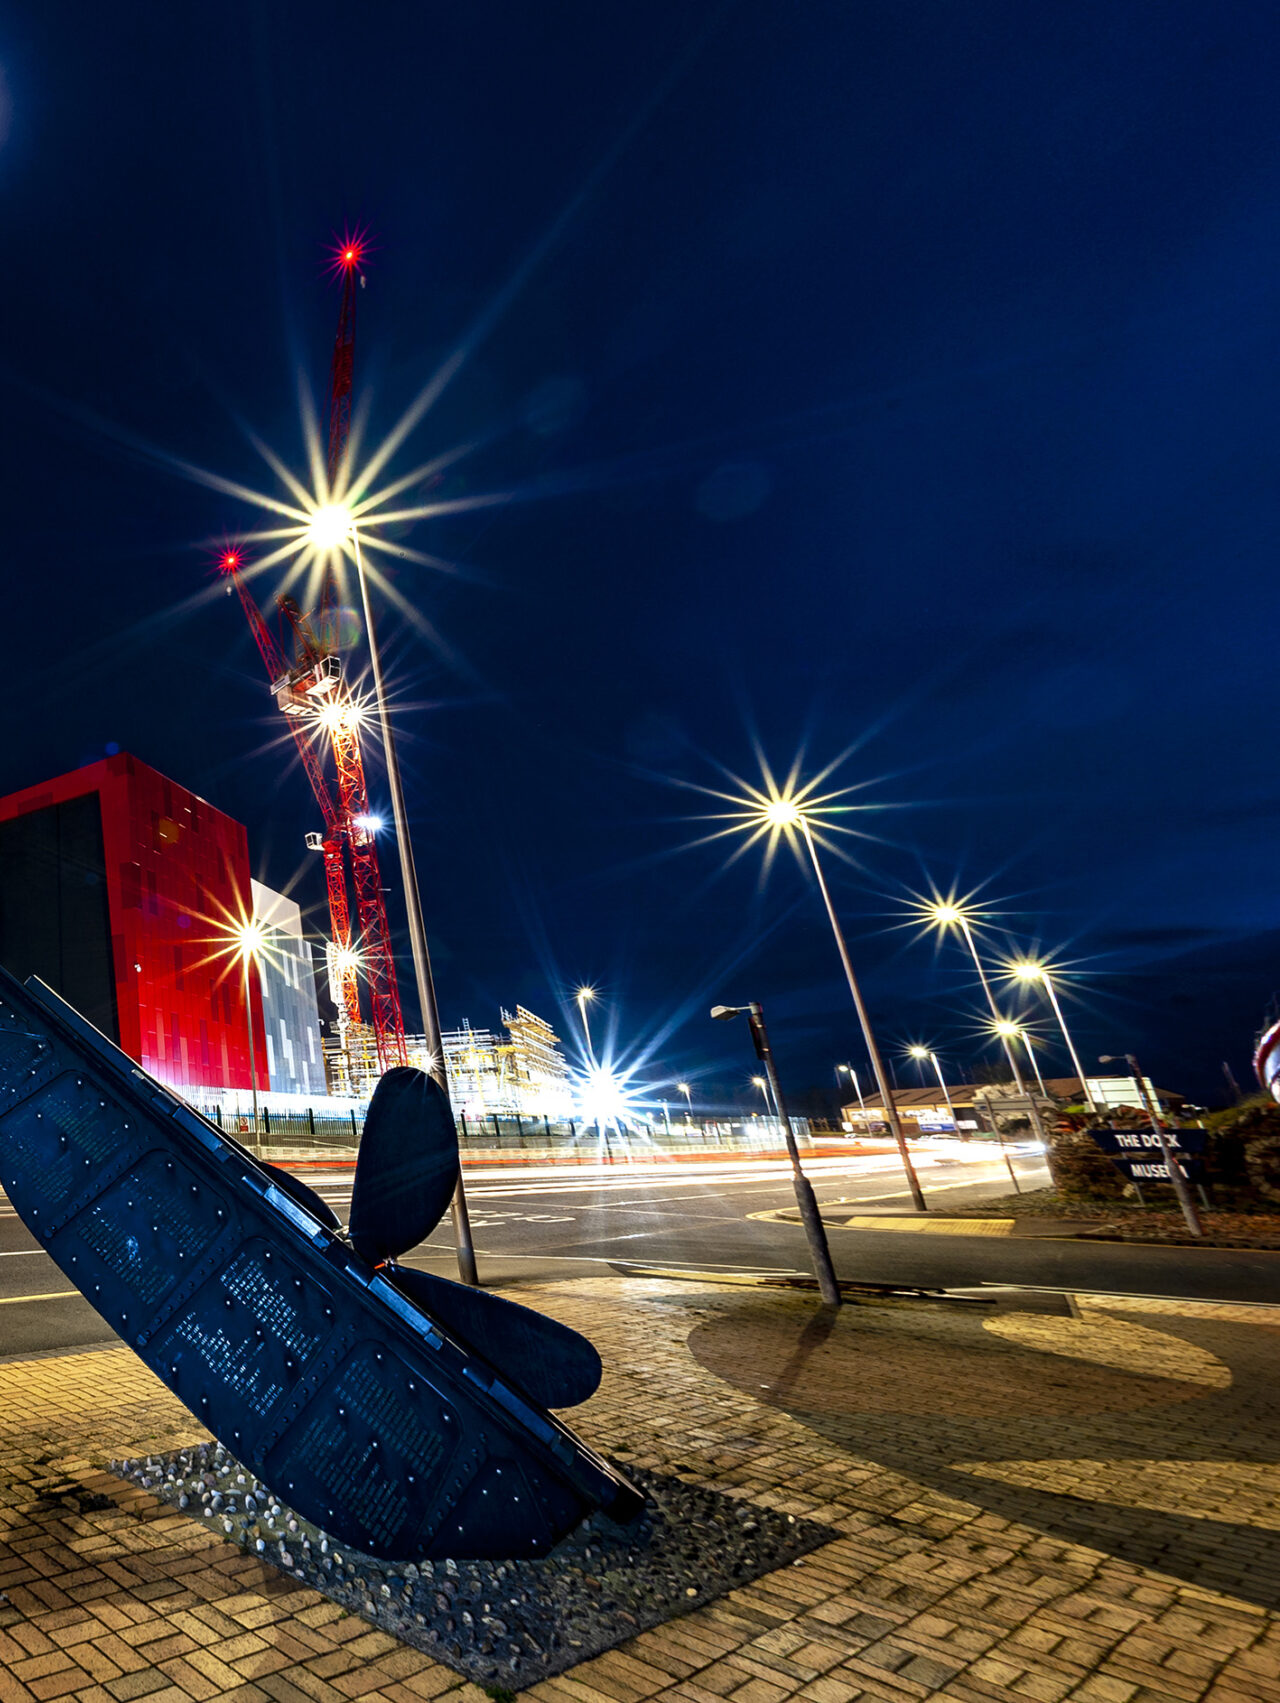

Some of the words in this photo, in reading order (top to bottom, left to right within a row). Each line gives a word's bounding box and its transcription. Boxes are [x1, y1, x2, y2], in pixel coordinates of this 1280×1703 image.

[1114, 1134, 1141, 1148] THE
[1140, 1134, 1183, 1148] DOK
[1130, 1164, 1190, 1179] MUSE
